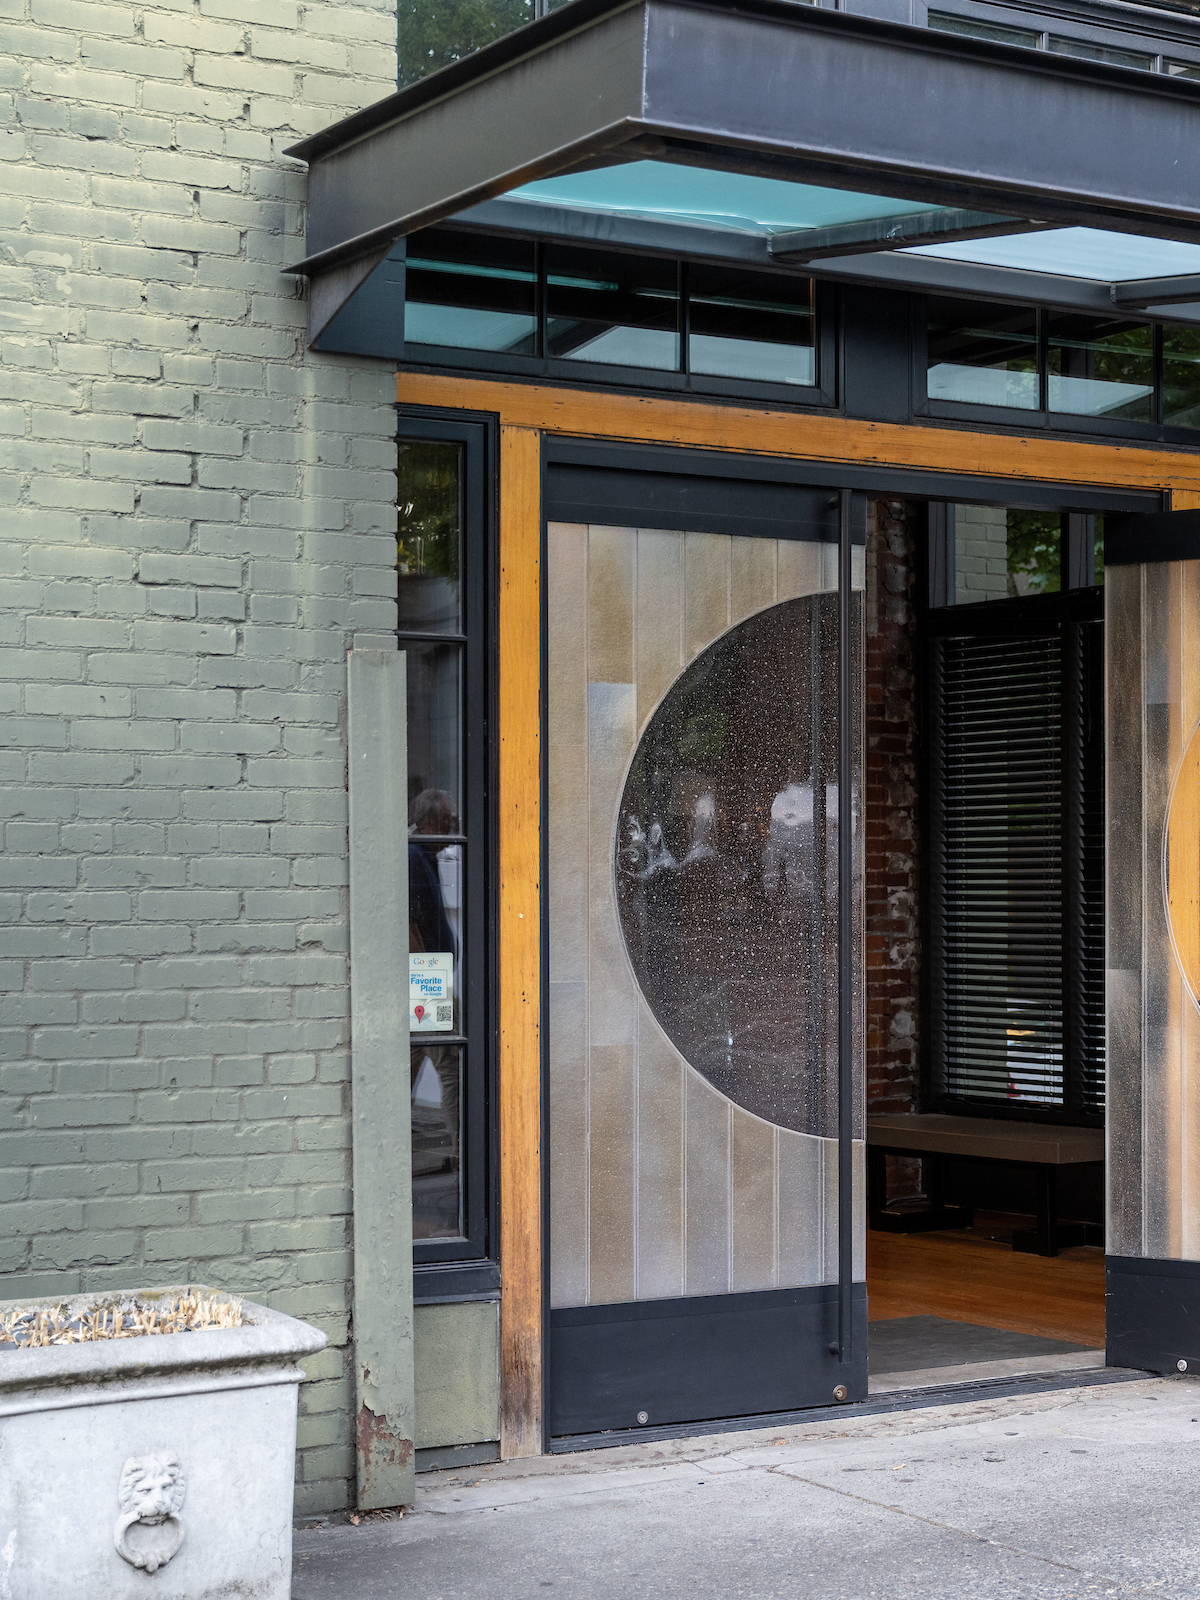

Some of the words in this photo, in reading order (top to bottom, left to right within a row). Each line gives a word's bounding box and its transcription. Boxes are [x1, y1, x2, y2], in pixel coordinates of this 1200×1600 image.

[413, 957, 439, 967] Google
[410, 977, 442, 985] Favorite
[420, 984, 442, 992] Place
